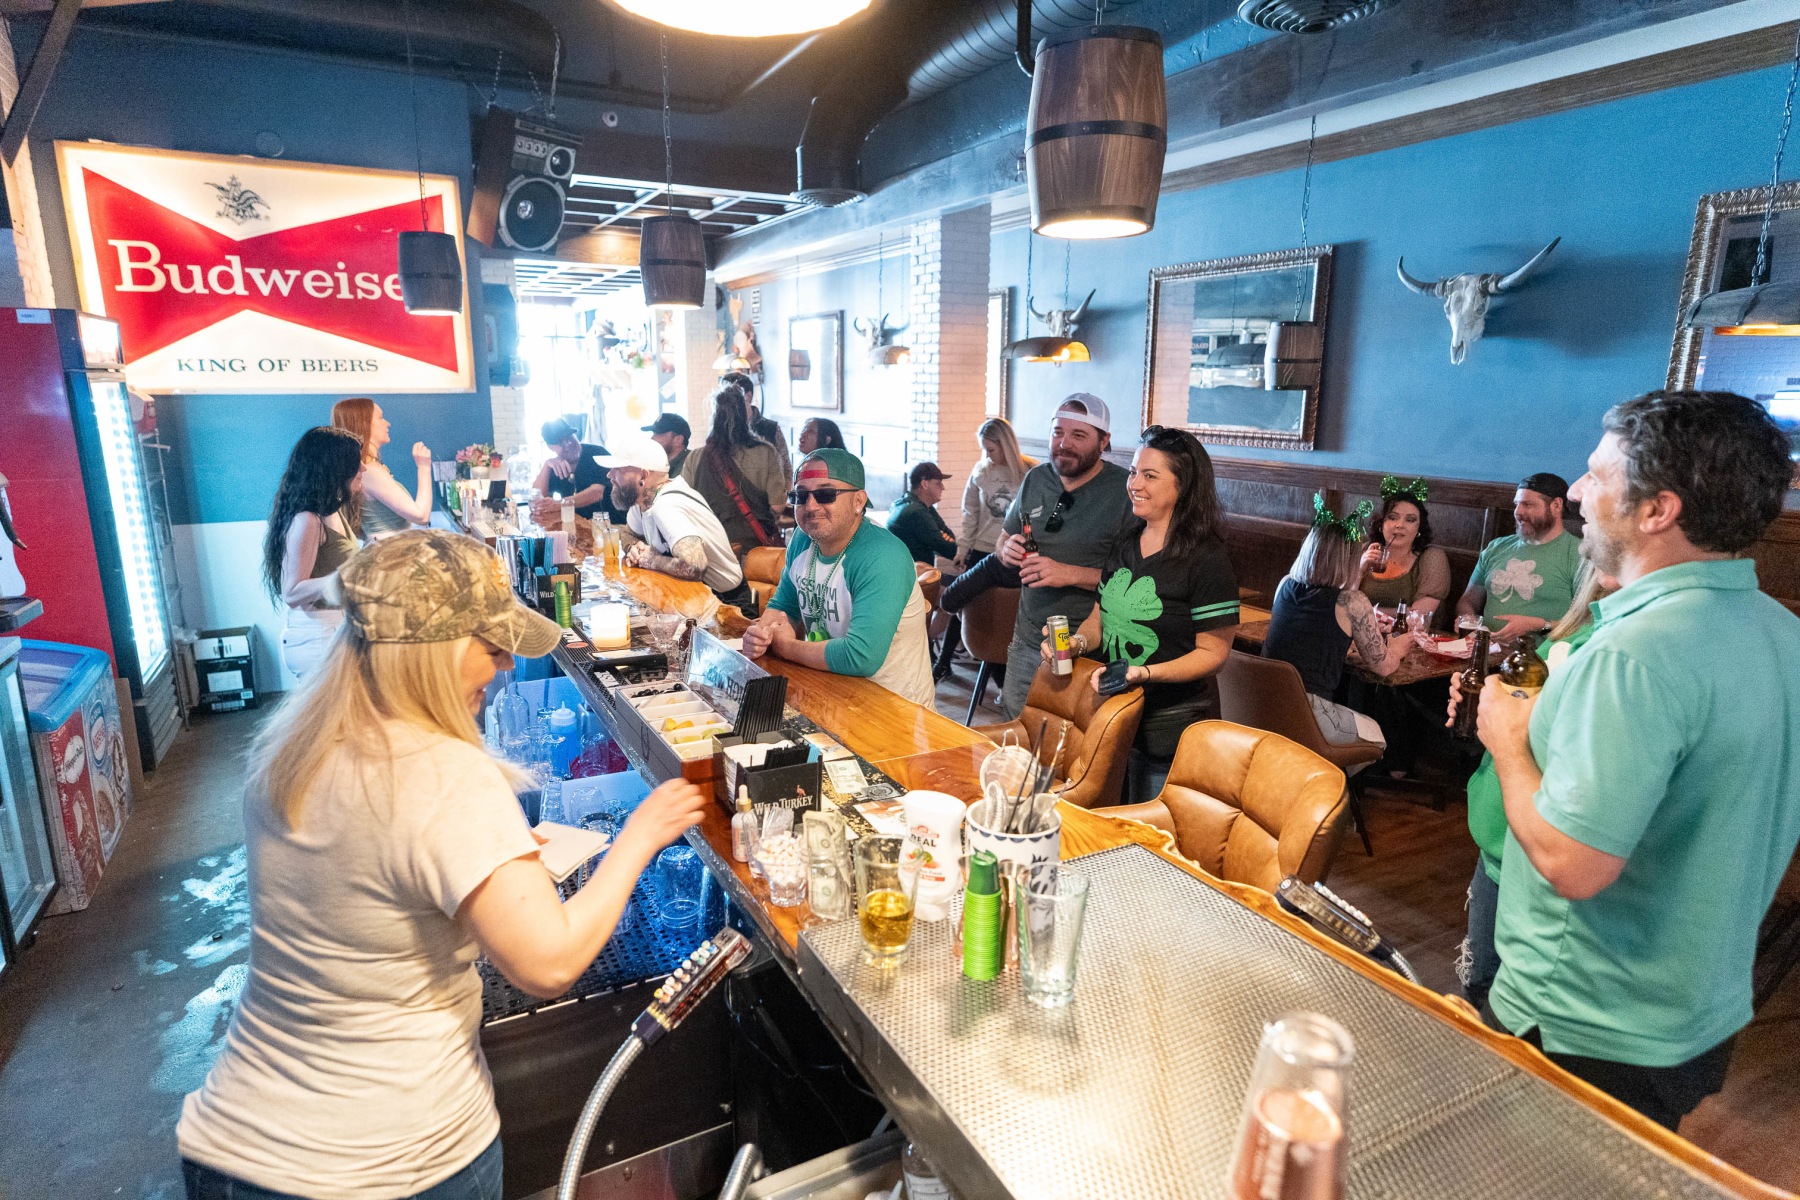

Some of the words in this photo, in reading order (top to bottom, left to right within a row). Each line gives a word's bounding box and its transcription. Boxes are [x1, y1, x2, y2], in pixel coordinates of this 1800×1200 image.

[107, 239, 405, 301] Budweise
[176, 358, 248, 373] KING
[257, 358, 291, 373] OF
[300, 358, 379, 373] BEERS
[778, 795, 814, 810] TURKEY
